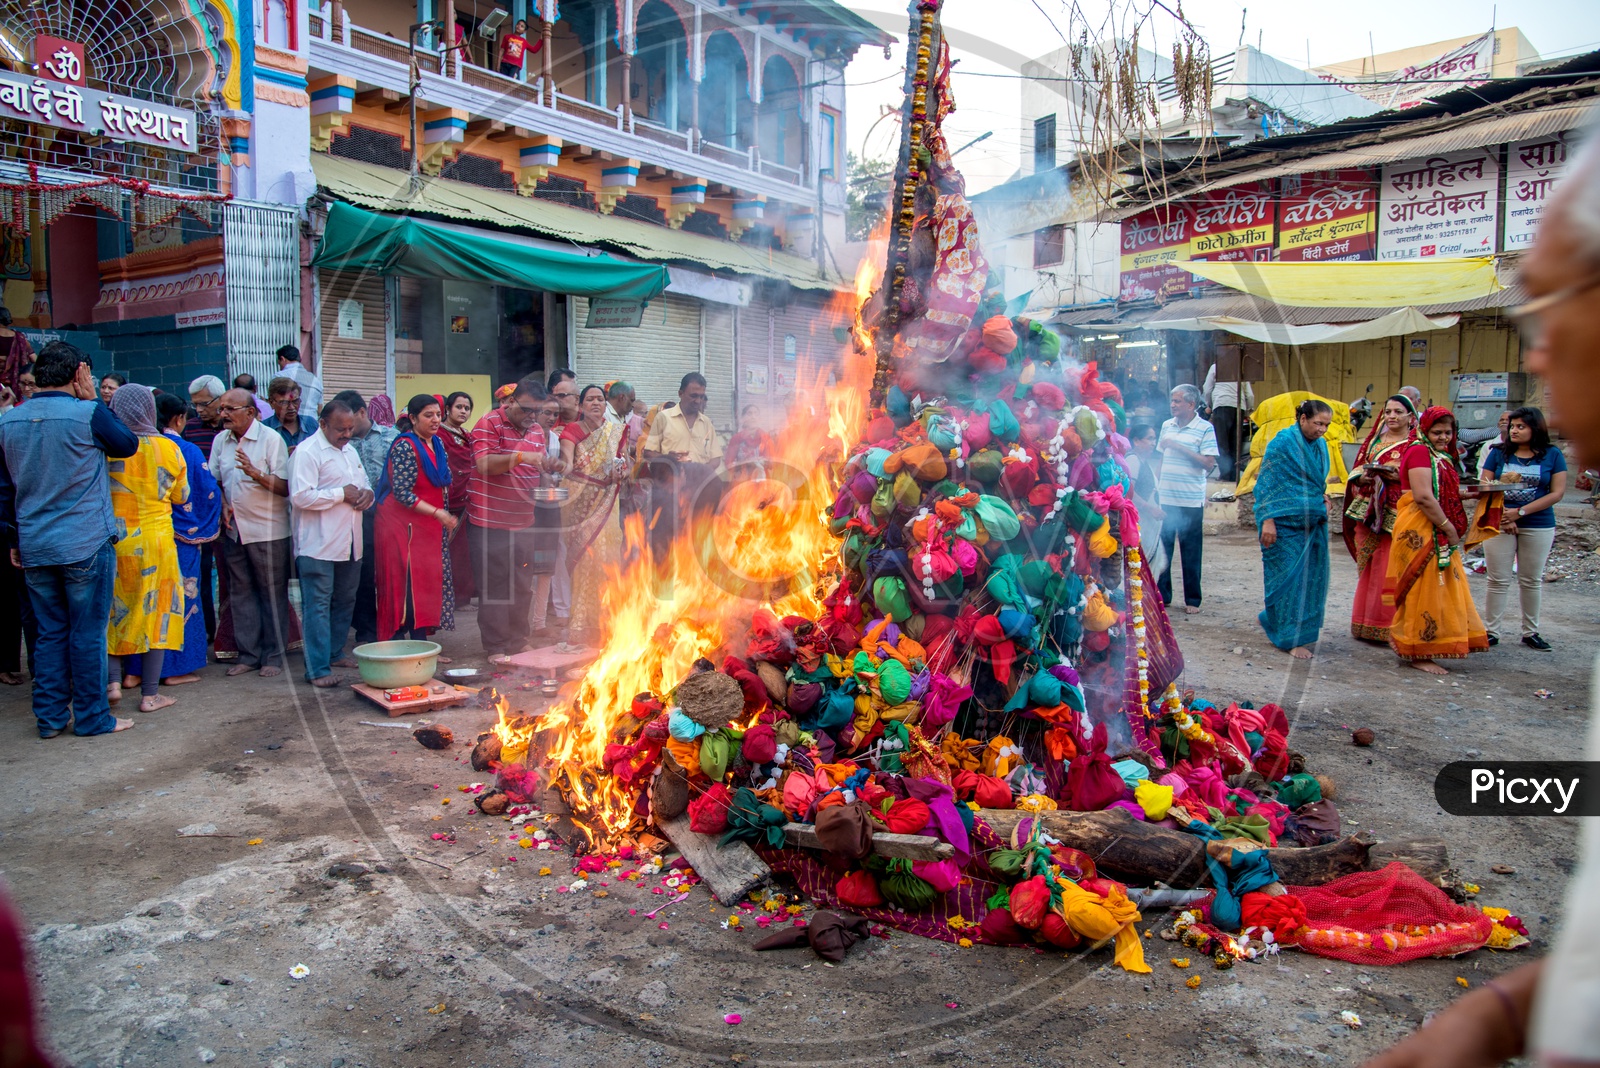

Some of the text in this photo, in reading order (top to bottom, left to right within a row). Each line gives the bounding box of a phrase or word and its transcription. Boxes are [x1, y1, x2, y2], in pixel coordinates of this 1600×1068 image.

[45, 46, 81, 81] ॐ
[0, 79, 191, 145] बादेवी संस्थान
[1390, 157, 1487, 194] साहिल
[1193, 191, 1271, 233] हरीश
[1387, 190, 1488, 222] ऑप्टीकल
[1123, 209, 1188, 251] वैष्णवी
[1197, 234, 1224, 251] फोटो
[1438, 227, 1477, 239] 9325717817
[1439, 243, 1462, 254] Crizal
